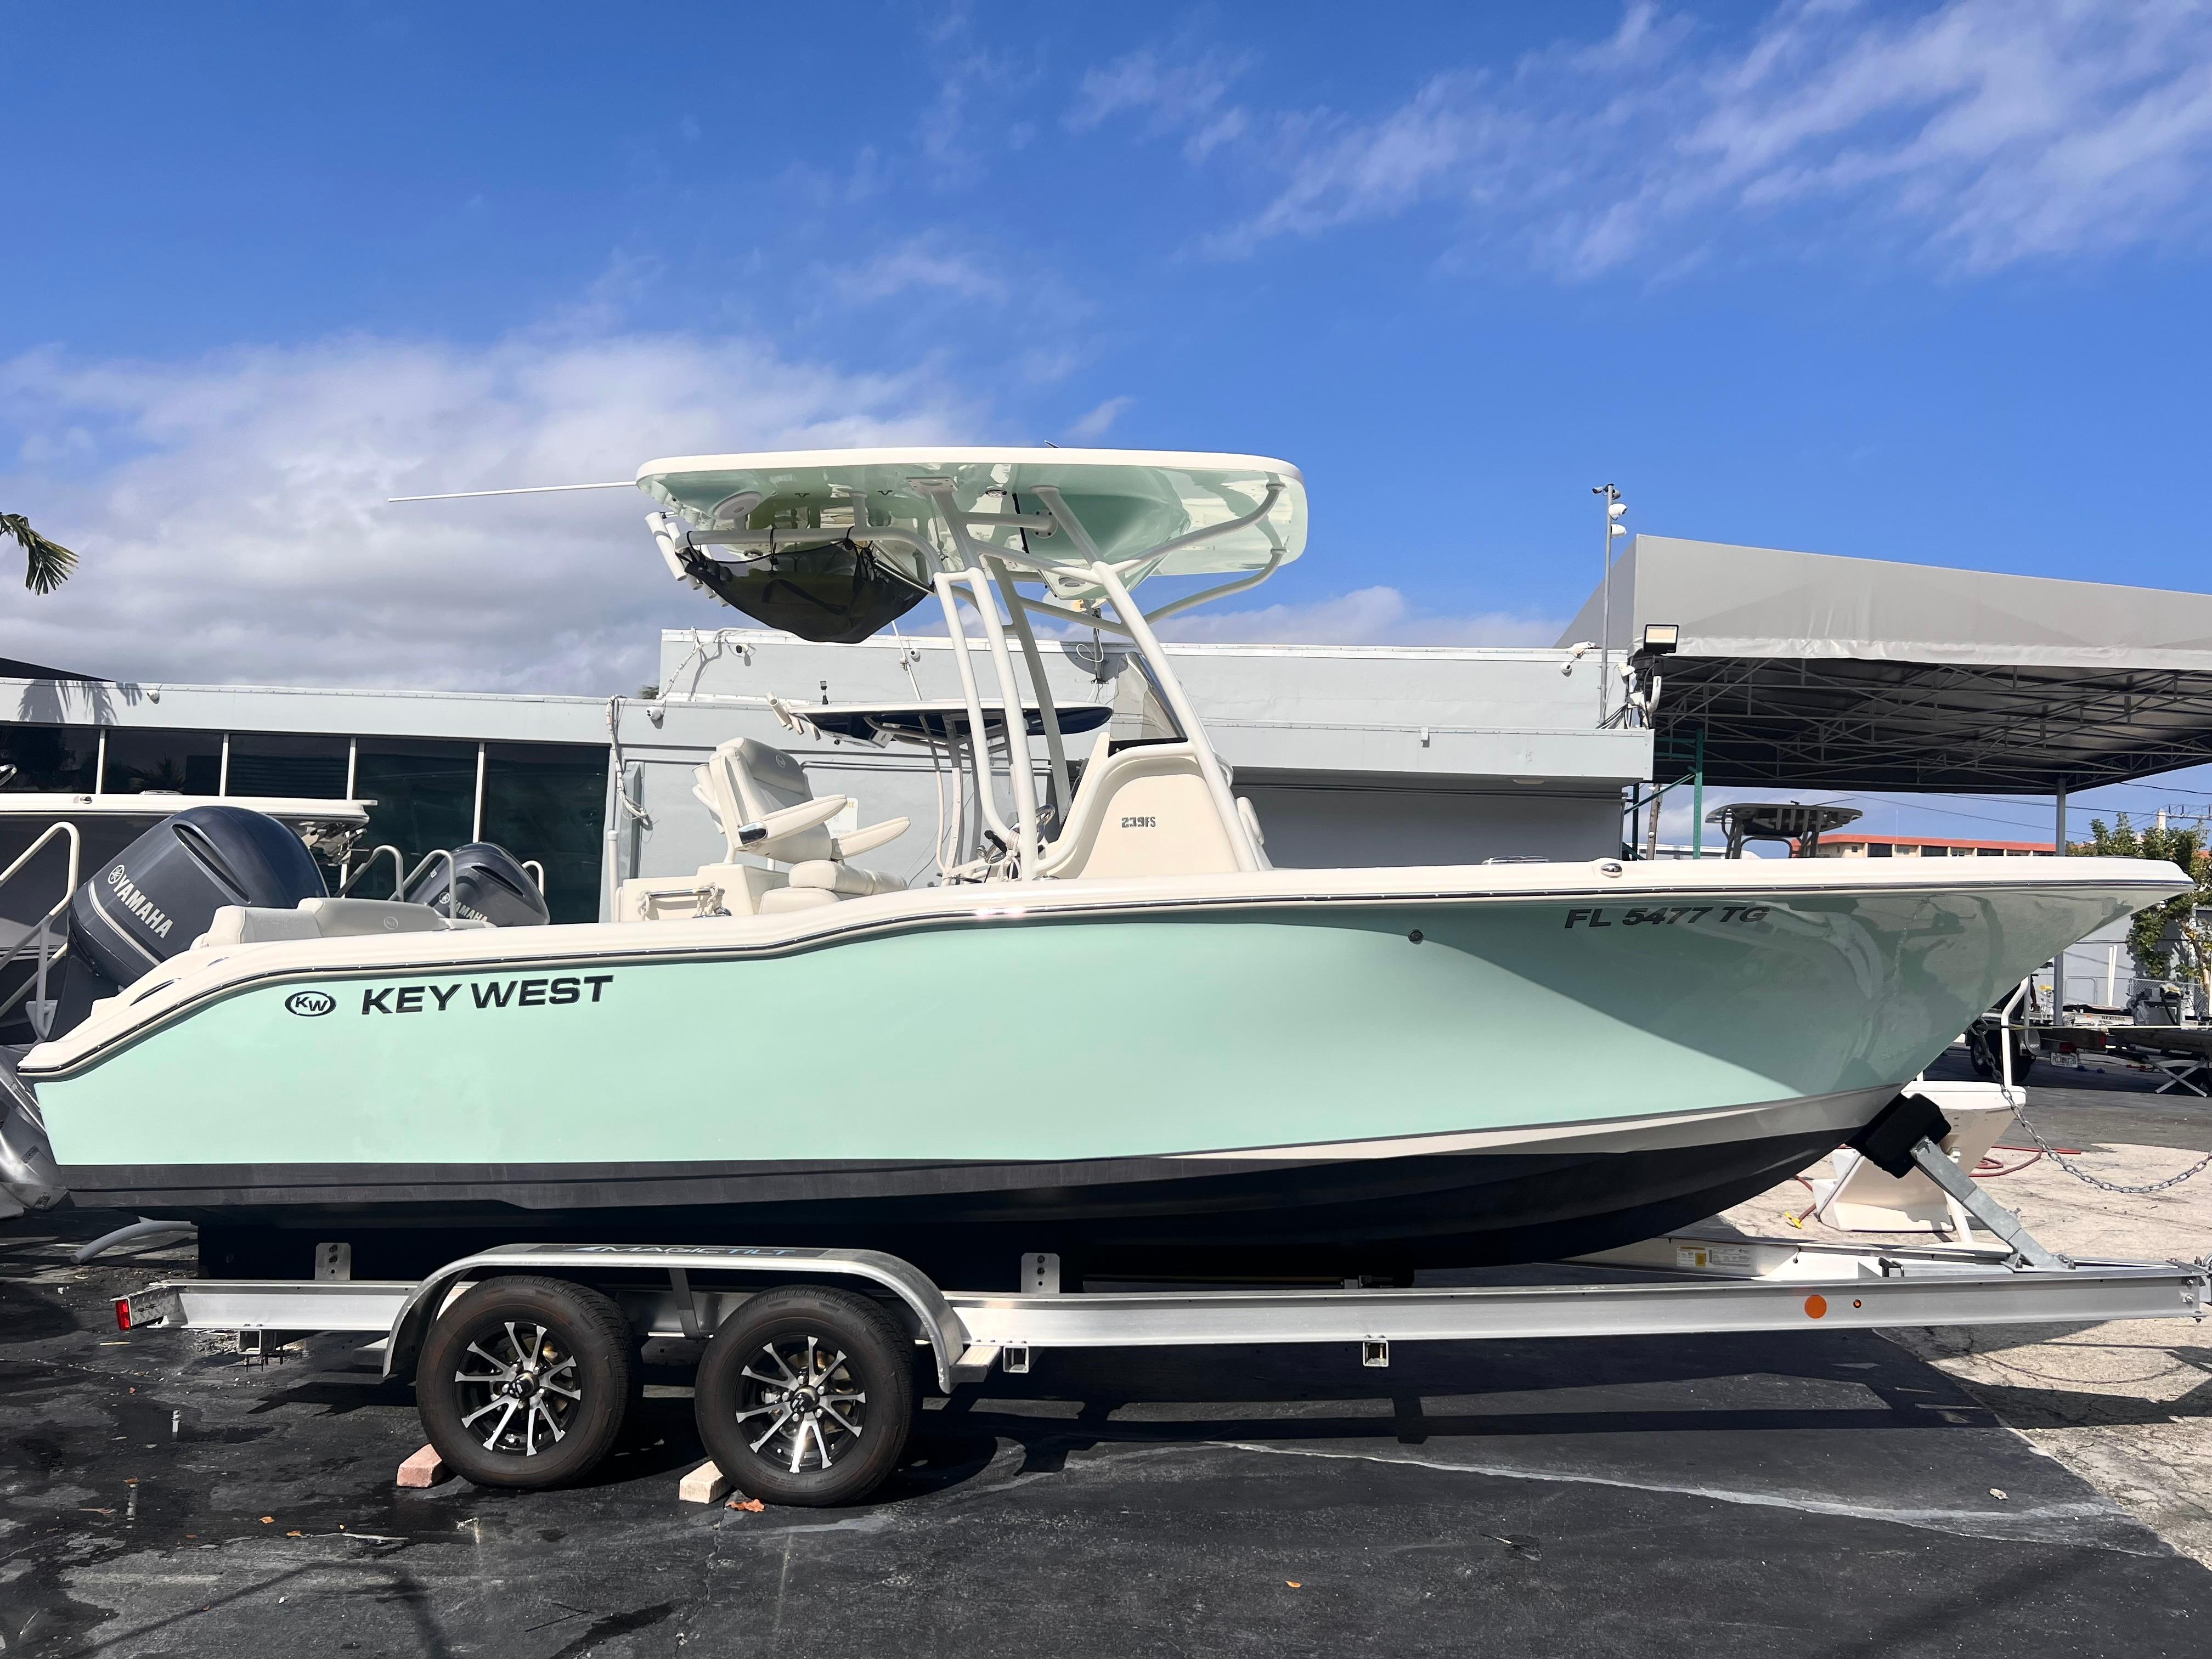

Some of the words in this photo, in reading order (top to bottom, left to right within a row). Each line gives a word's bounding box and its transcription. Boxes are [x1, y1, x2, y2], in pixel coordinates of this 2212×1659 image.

[1121, 816, 1156, 828] 239FS
[113, 874, 173, 939] YAMAHA
[449, 900, 488, 922] AMAHA
[1565, 909, 1611, 929] FL
[1622, 907, 1713, 926] 5477
[1720, 906, 1770, 922] TG
[295, 996, 328, 1011] KW
[362, 983, 462, 1015] KEY
[470, 974, 614, 1009] WEST
